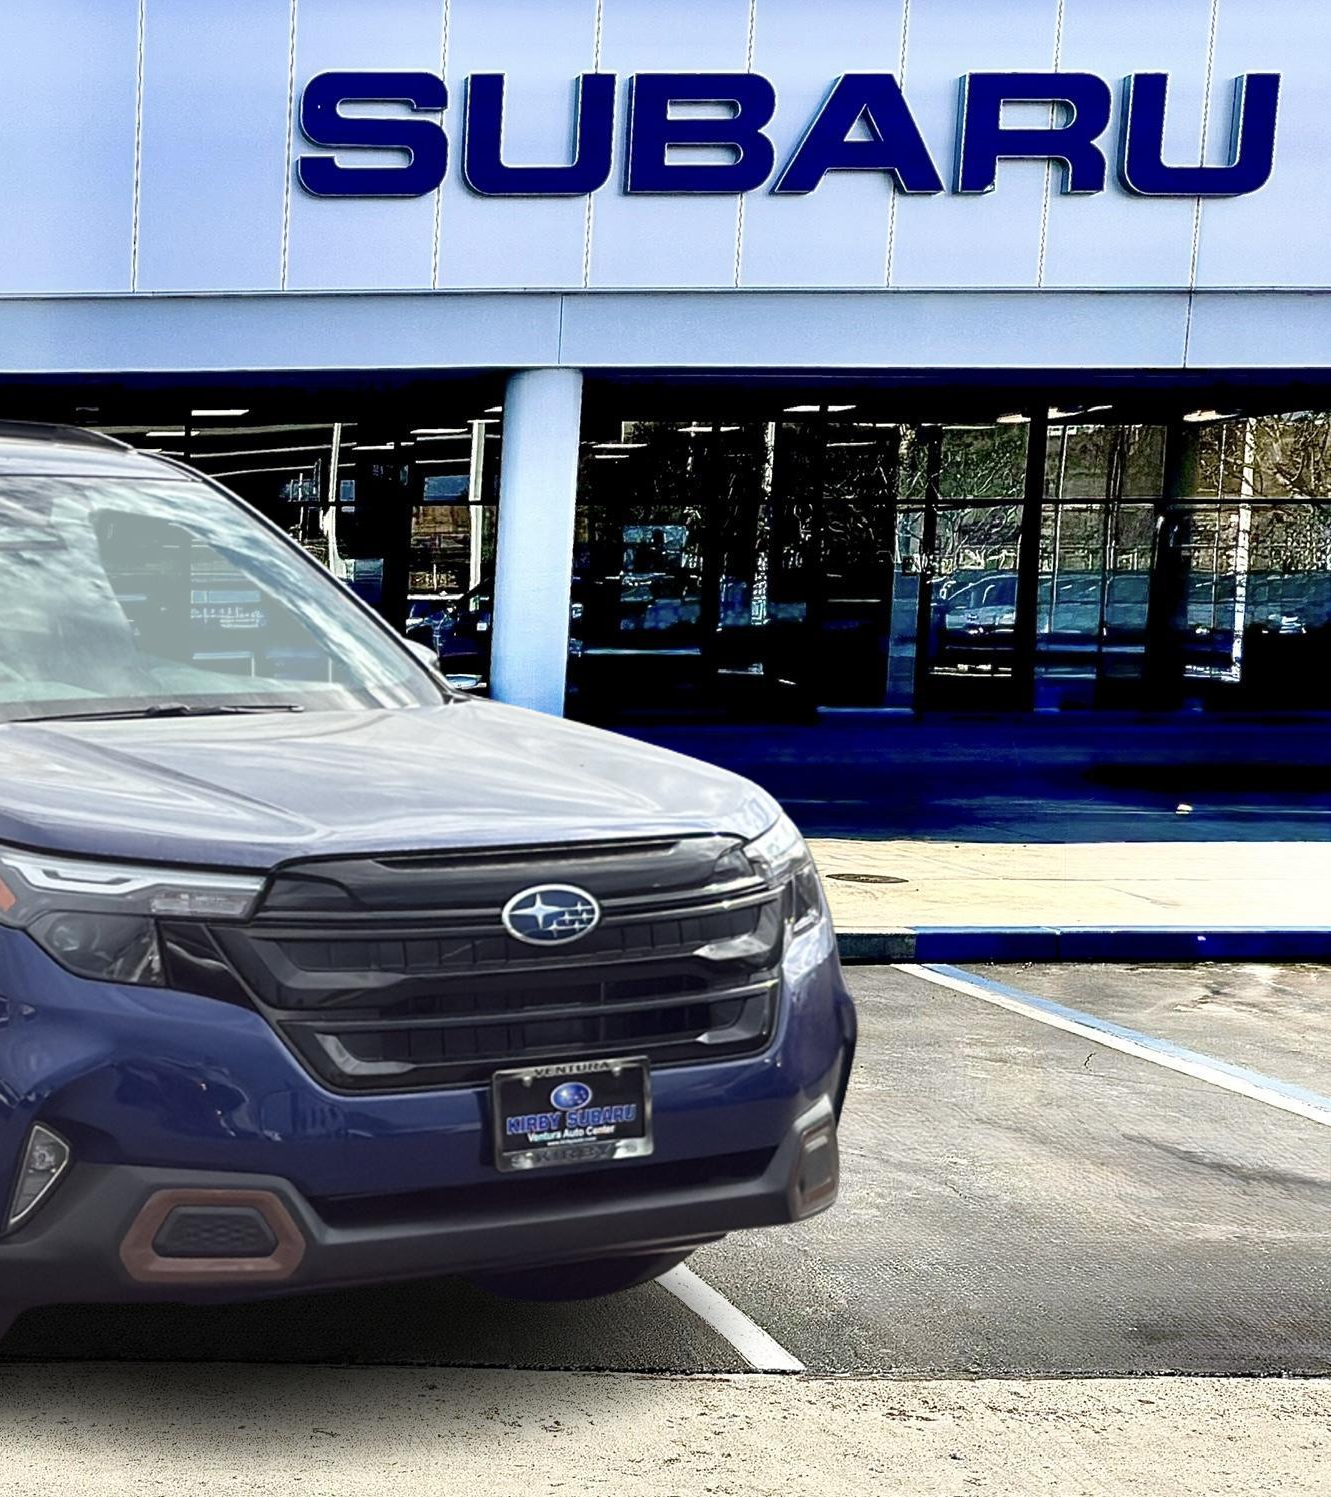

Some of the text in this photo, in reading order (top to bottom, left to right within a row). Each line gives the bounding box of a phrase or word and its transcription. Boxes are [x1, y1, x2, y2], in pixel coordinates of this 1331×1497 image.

[297, 71, 1281, 198] SUBARU
[533, 1061, 611, 1078] VENTURA
[506, 1103, 637, 1135] KIRBY SUBARU
[527, 1129, 562, 1143] Ventura
[562, 1126, 585, 1138] Auto
[586, 1124, 616, 1136] Center
